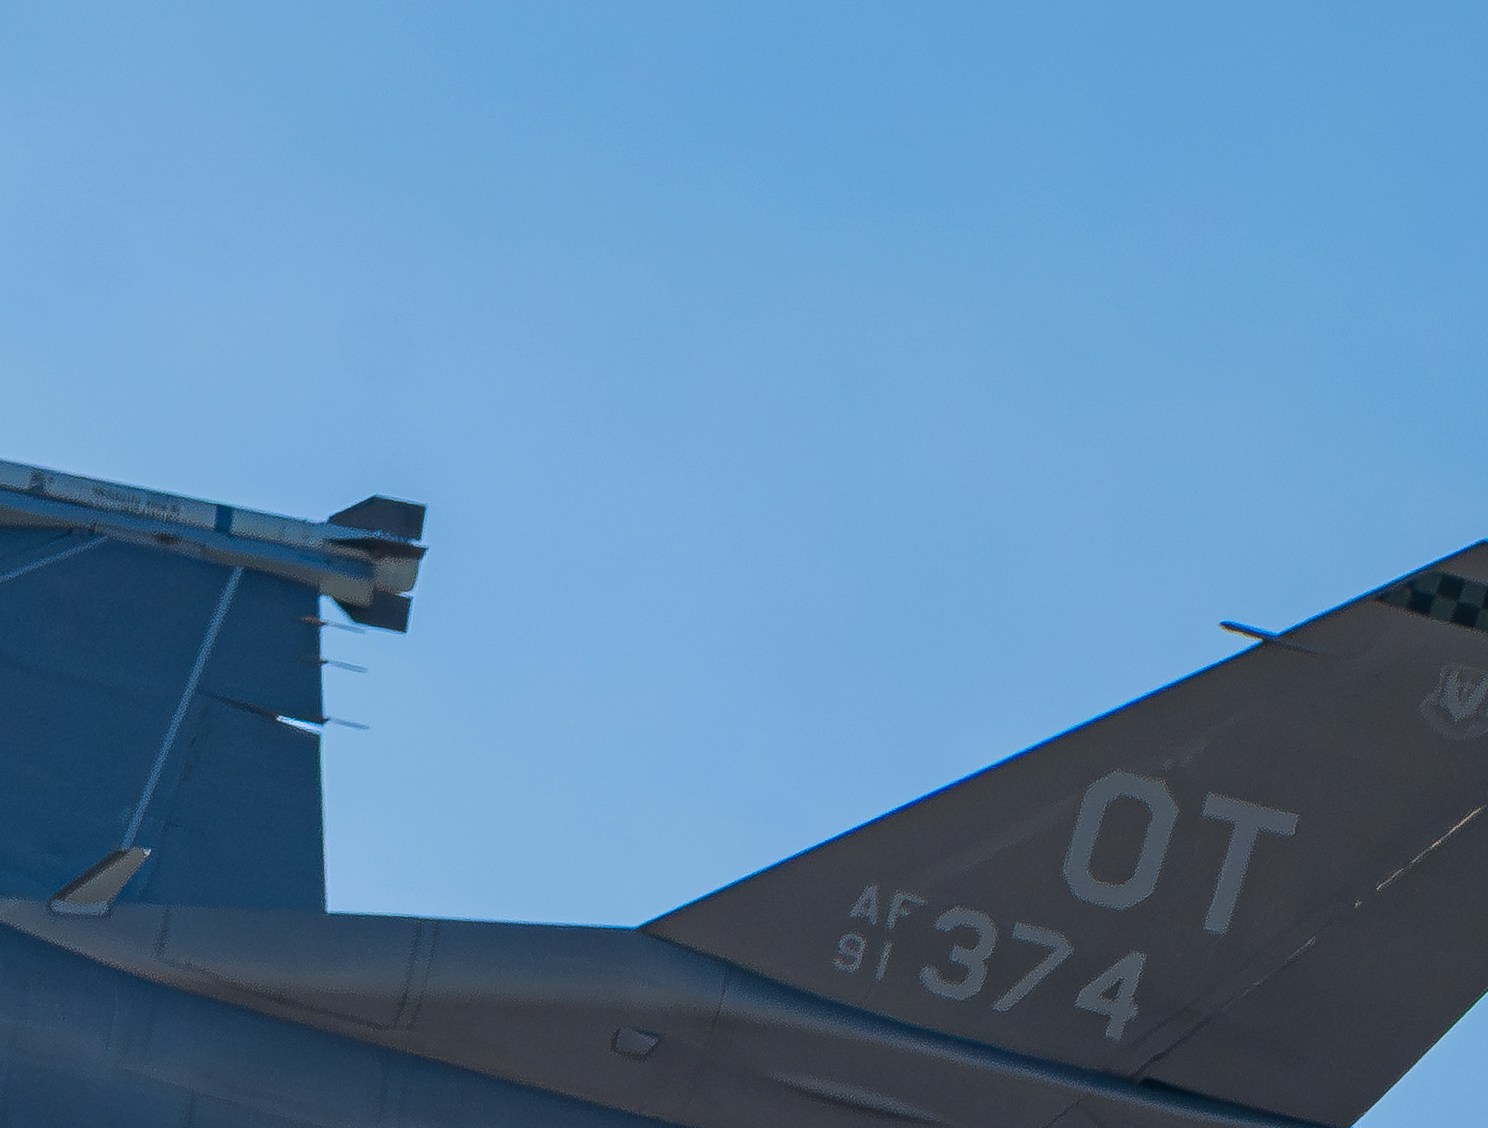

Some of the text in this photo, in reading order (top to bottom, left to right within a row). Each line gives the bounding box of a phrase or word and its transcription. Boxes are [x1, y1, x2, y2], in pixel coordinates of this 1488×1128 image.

[1062, 768, 1300, 936] OT
[849, 884, 926, 931] AF
[832, 931, 893, 982] 91
[920, 906, 1148, 1042] 374
